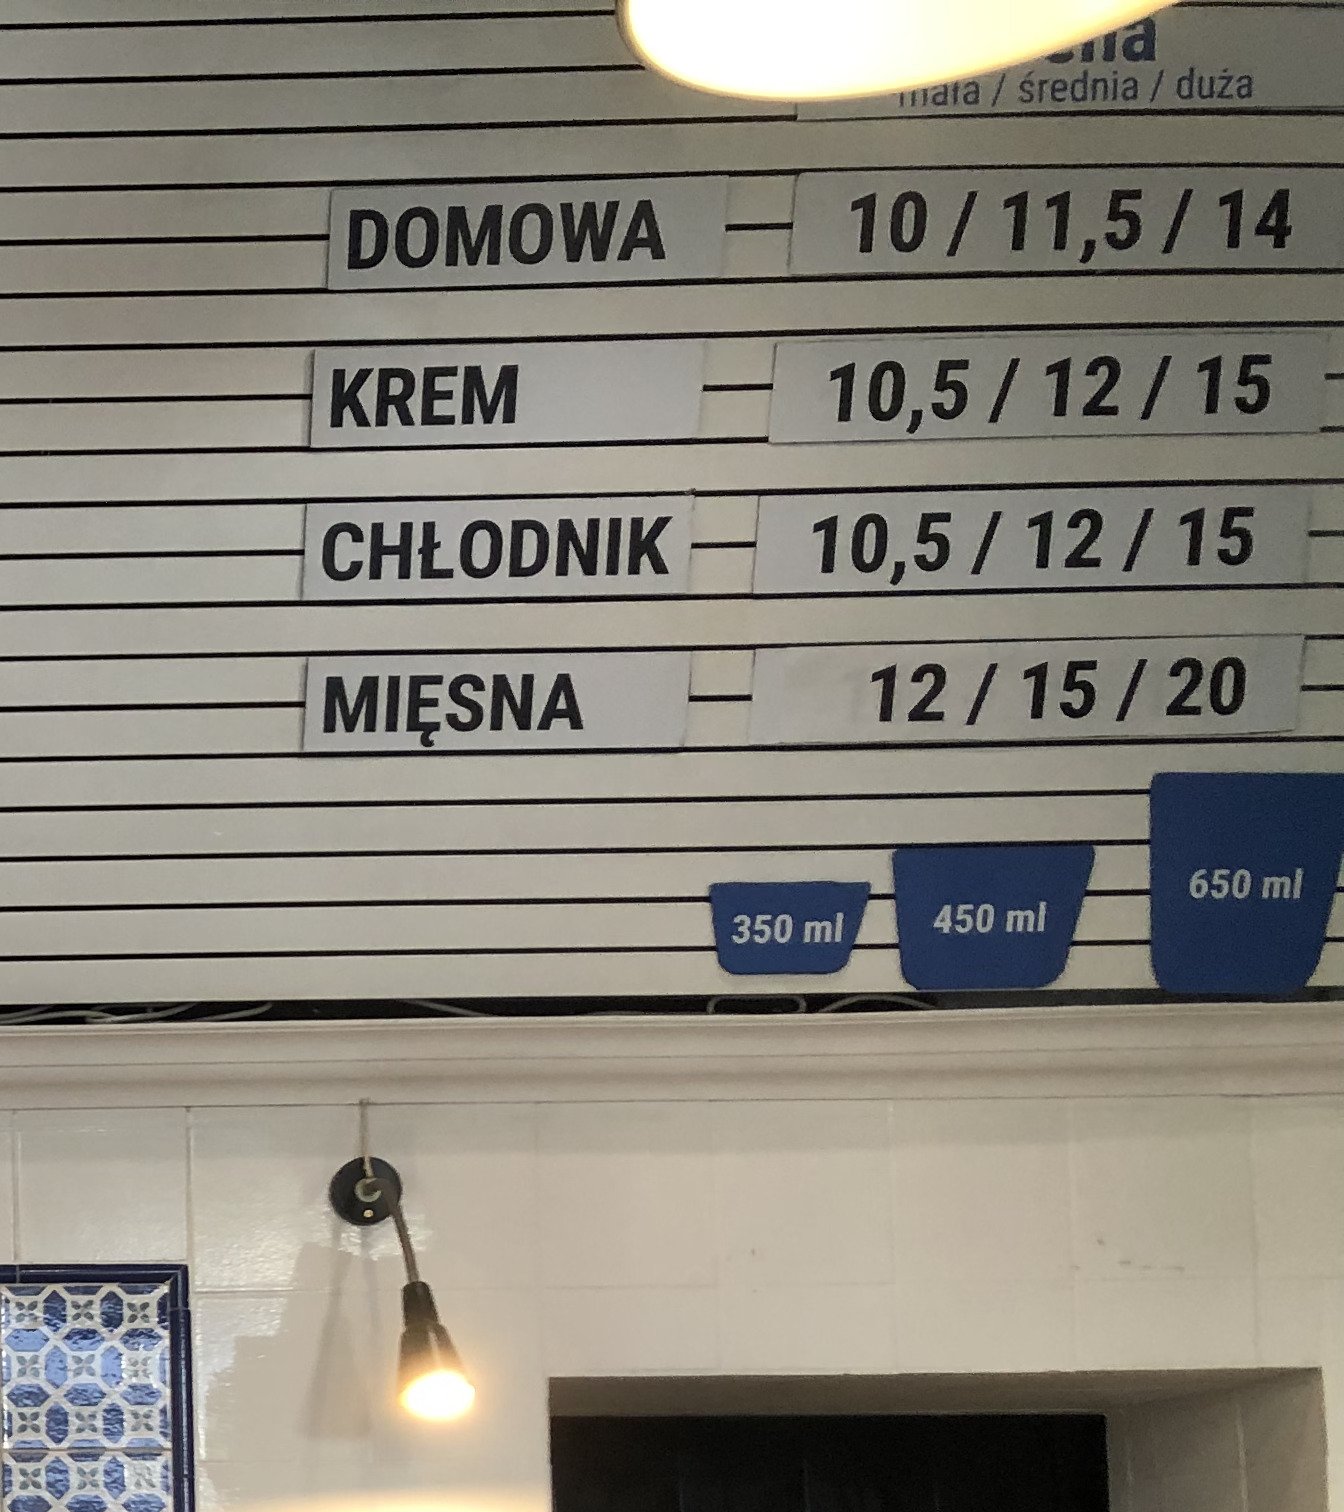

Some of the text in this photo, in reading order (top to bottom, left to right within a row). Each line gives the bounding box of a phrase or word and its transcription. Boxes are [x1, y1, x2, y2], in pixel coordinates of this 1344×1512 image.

[1018, 68, 1139, 104] średnia
[1176, 66, 1254, 100] duża
[347, 200, 666, 270] DOMOWA
[850, 192, 927, 254] 10
[1002, 188, 1142, 264] 11,5
[1218, 188, 1293, 251] 14
[330, 365, 521, 428] KREM
[828, 358, 971, 434] 10,5
[1043, 357, 1122, 420] 12
[1197, 354, 1275, 417] 15
[321, 514, 673, 582] CHŁODNIK
[812, 512, 952, 586] 10,5
[1026, 509, 1105, 571] 12
[1179, 505, 1255, 569] 15
[322, 673, 584, 747] MIĘSNA
[870, 663, 946, 724] 12
[1021, 660, 1099, 721] 15
[1166, 656, 1248, 717] 20
[1189, 867, 1304, 900] 650 ml
[732, 912, 843, 945] 350 ml
[933, 902, 1047, 935] 450 ml
